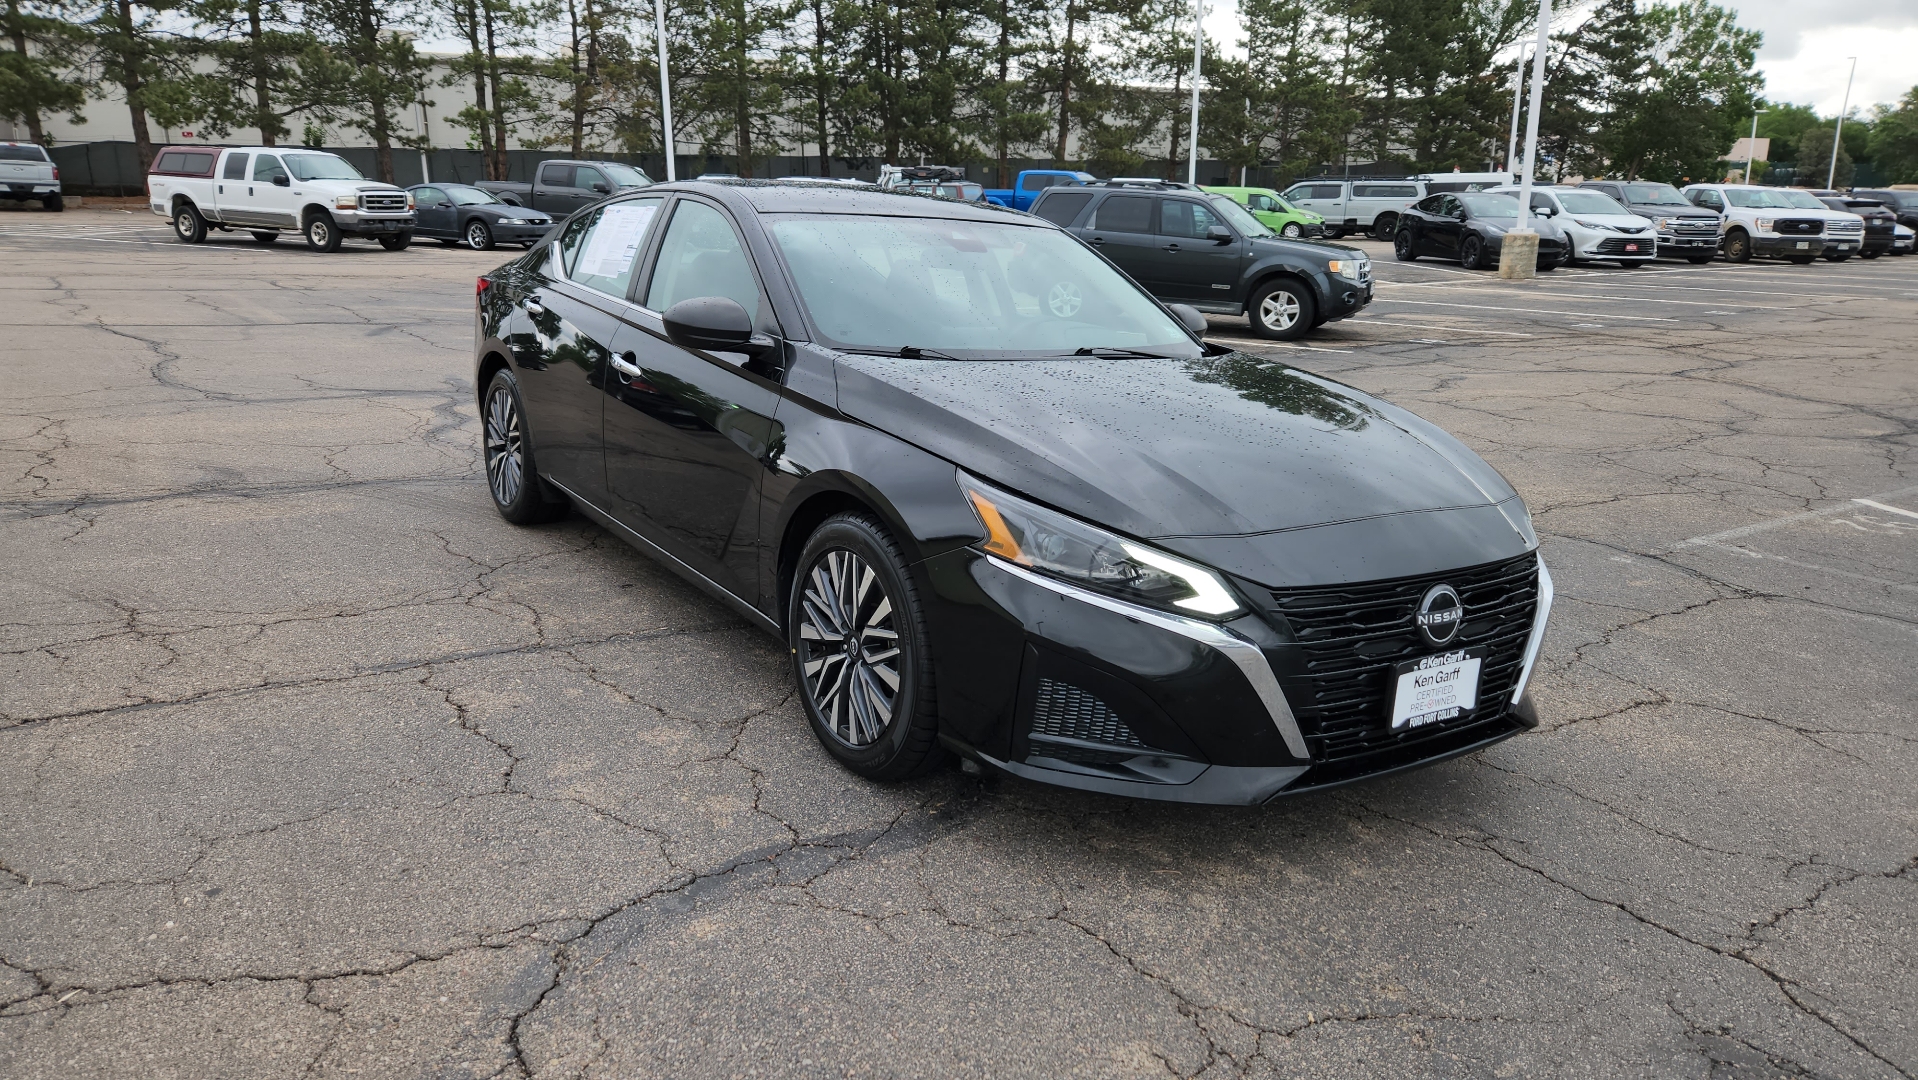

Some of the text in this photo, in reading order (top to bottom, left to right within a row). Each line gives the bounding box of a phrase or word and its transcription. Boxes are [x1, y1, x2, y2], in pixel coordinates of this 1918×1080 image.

[1418, 607, 1462, 624] NISSAN
[1414, 667, 1461, 689] Ken Garff
[1416, 685, 1453, 700] CERTIFIED
[1409, 707, 1460, 728] FORD FORT COLLINS
